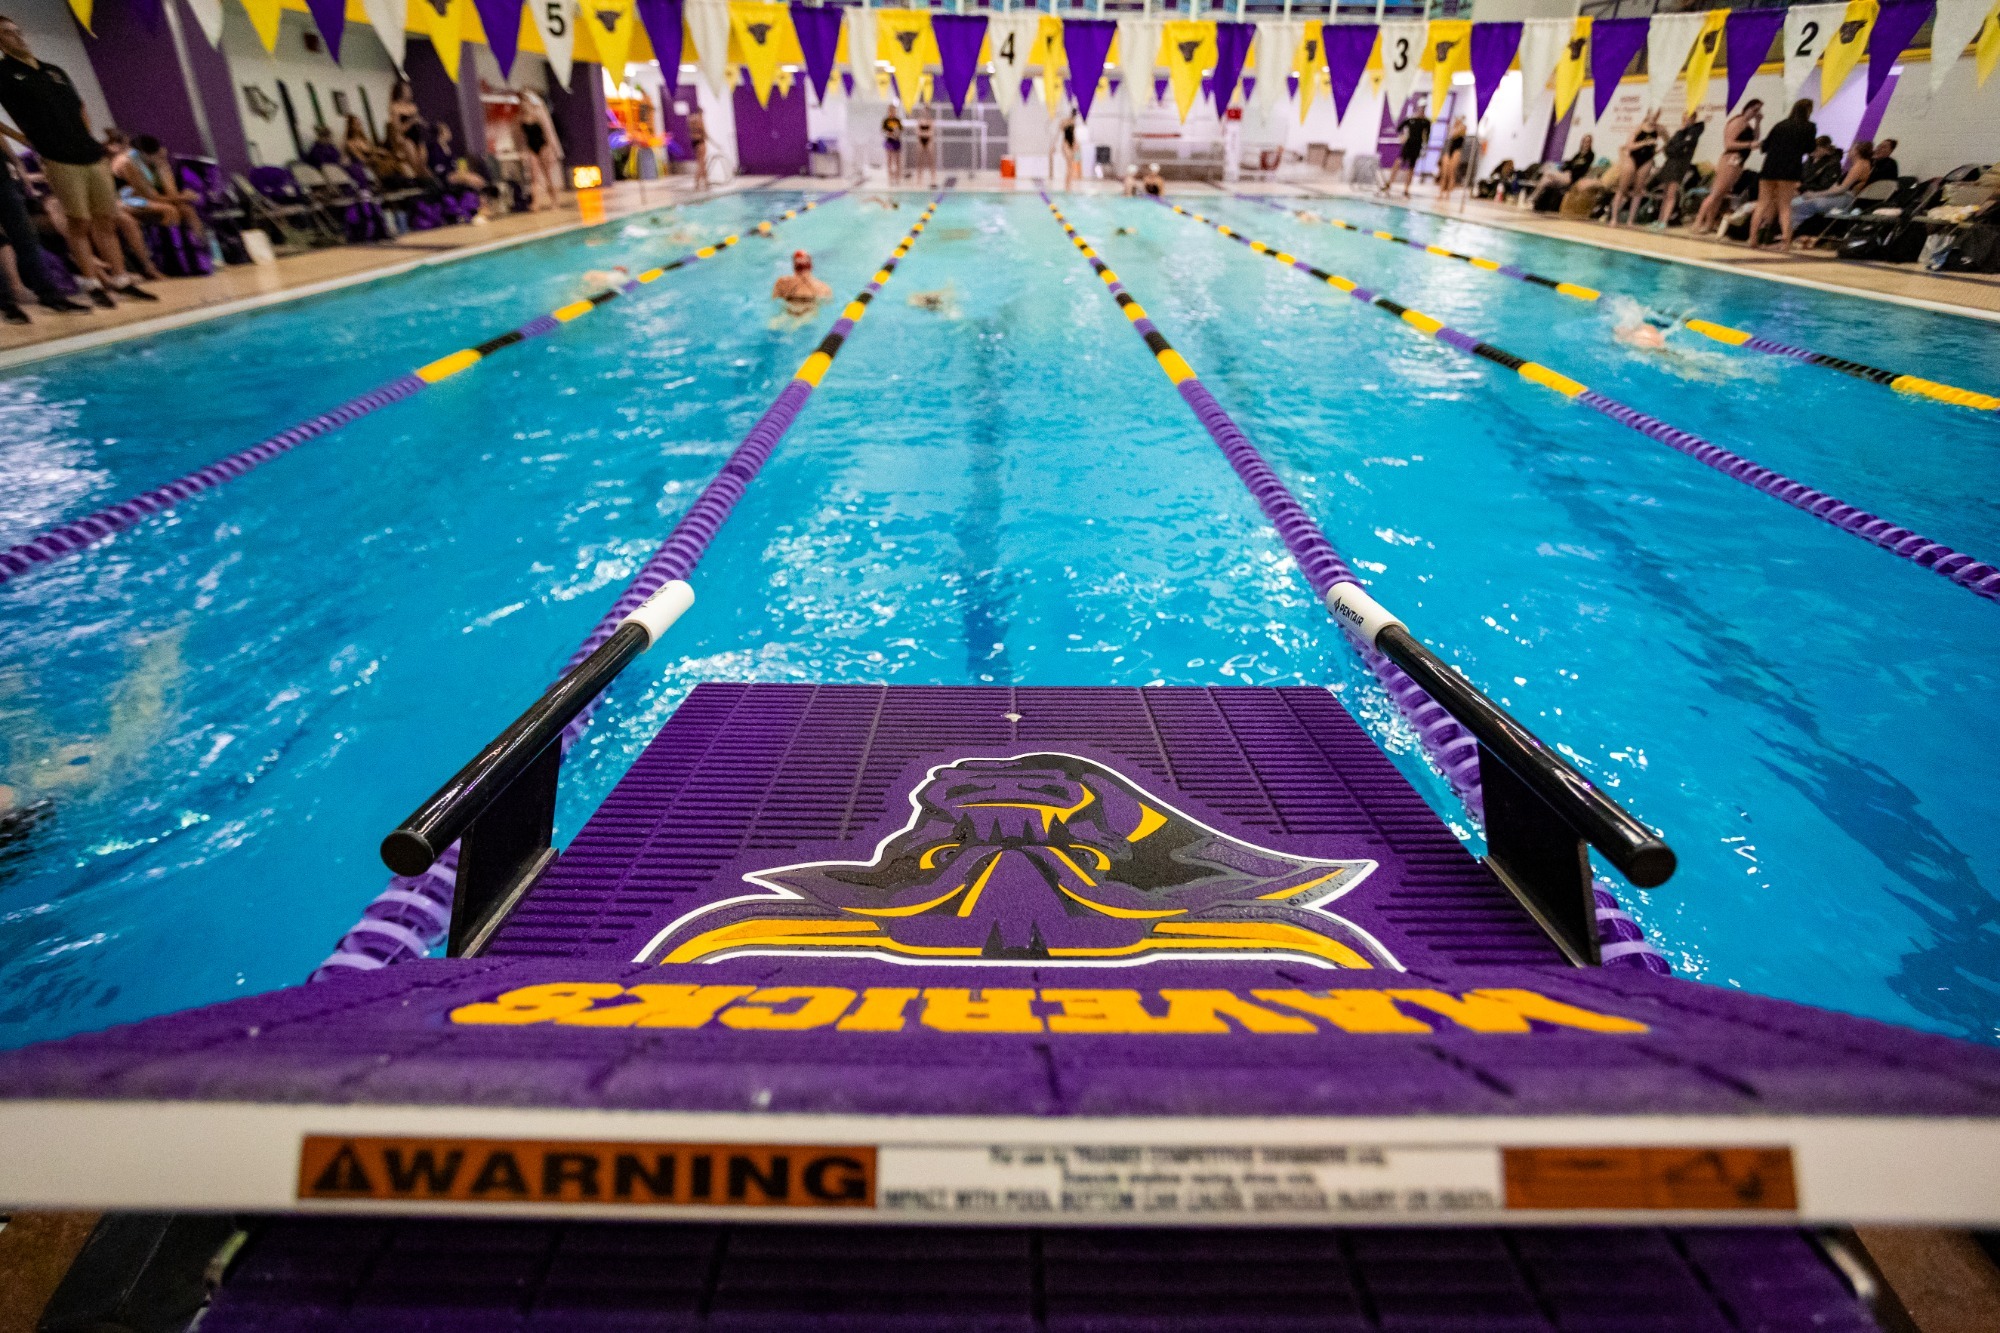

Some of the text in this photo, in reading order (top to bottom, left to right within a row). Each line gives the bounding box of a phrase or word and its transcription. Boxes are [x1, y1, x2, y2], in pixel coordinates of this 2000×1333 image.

[547, 3, 565, 36] 5
[1000, 32, 1015, 65] 4
[1393, 38, 1409, 72] 3
[1795, 21, 1819, 57] 2
[1339, 603, 1364, 627] PENTAIR
[450, 982, 1651, 1034] MAVERICKS
[383, 1149, 868, 1201] WARNING
